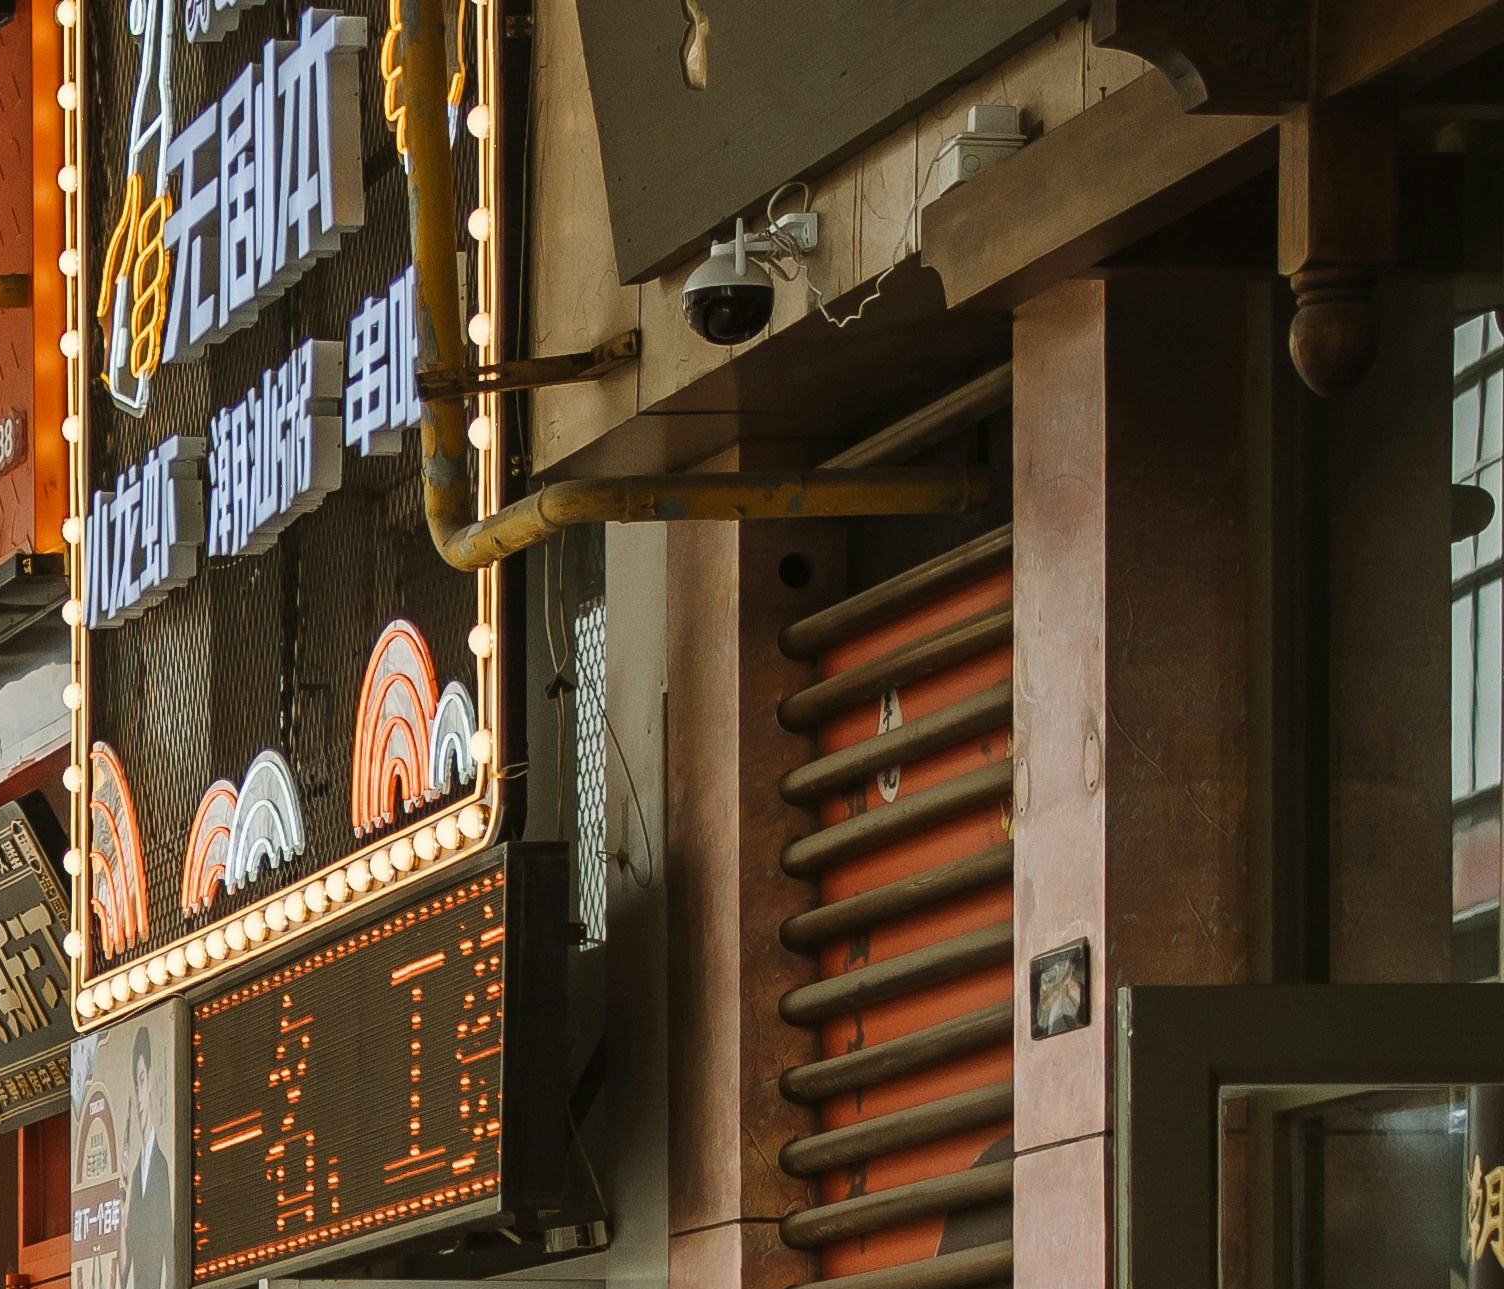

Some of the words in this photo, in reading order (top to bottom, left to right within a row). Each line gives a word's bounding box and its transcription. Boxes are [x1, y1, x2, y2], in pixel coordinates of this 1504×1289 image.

[163, 6, 339, 363] 无剧本
[83, 434, 178, 630] 小龙虾
[208, 338, 313, 556] 潮汕粥
